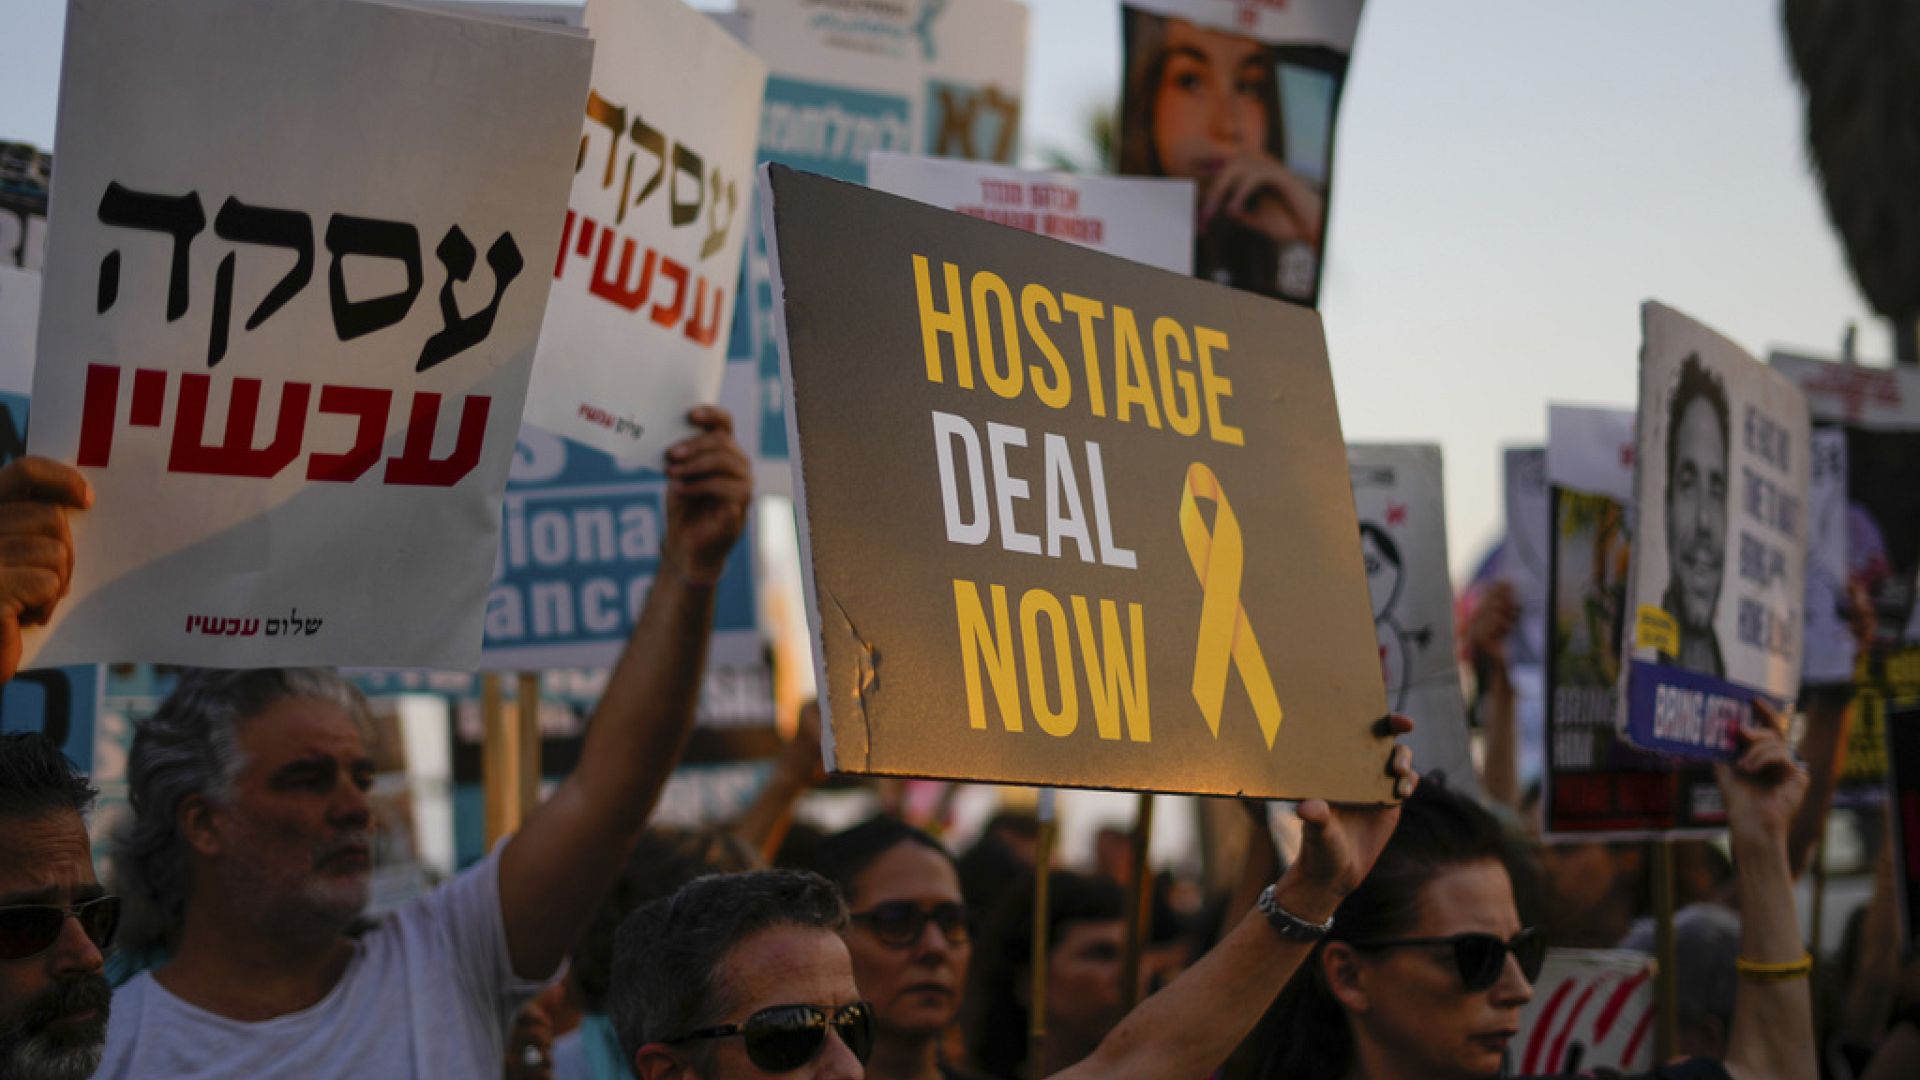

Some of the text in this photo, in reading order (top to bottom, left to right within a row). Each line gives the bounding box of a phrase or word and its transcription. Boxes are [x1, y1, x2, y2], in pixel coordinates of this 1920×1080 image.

[97, 180, 524, 373] עסקה
[912, 253, 1246, 446] HOSTAGE
[77, 363, 492, 487] עכשיו
[931, 410, 1138, 570] DEAL
[503, 498, 662, 568] iona
[185, 608, 323, 636] שלום עכשיו
[952, 578, 1152, 744] NOW
